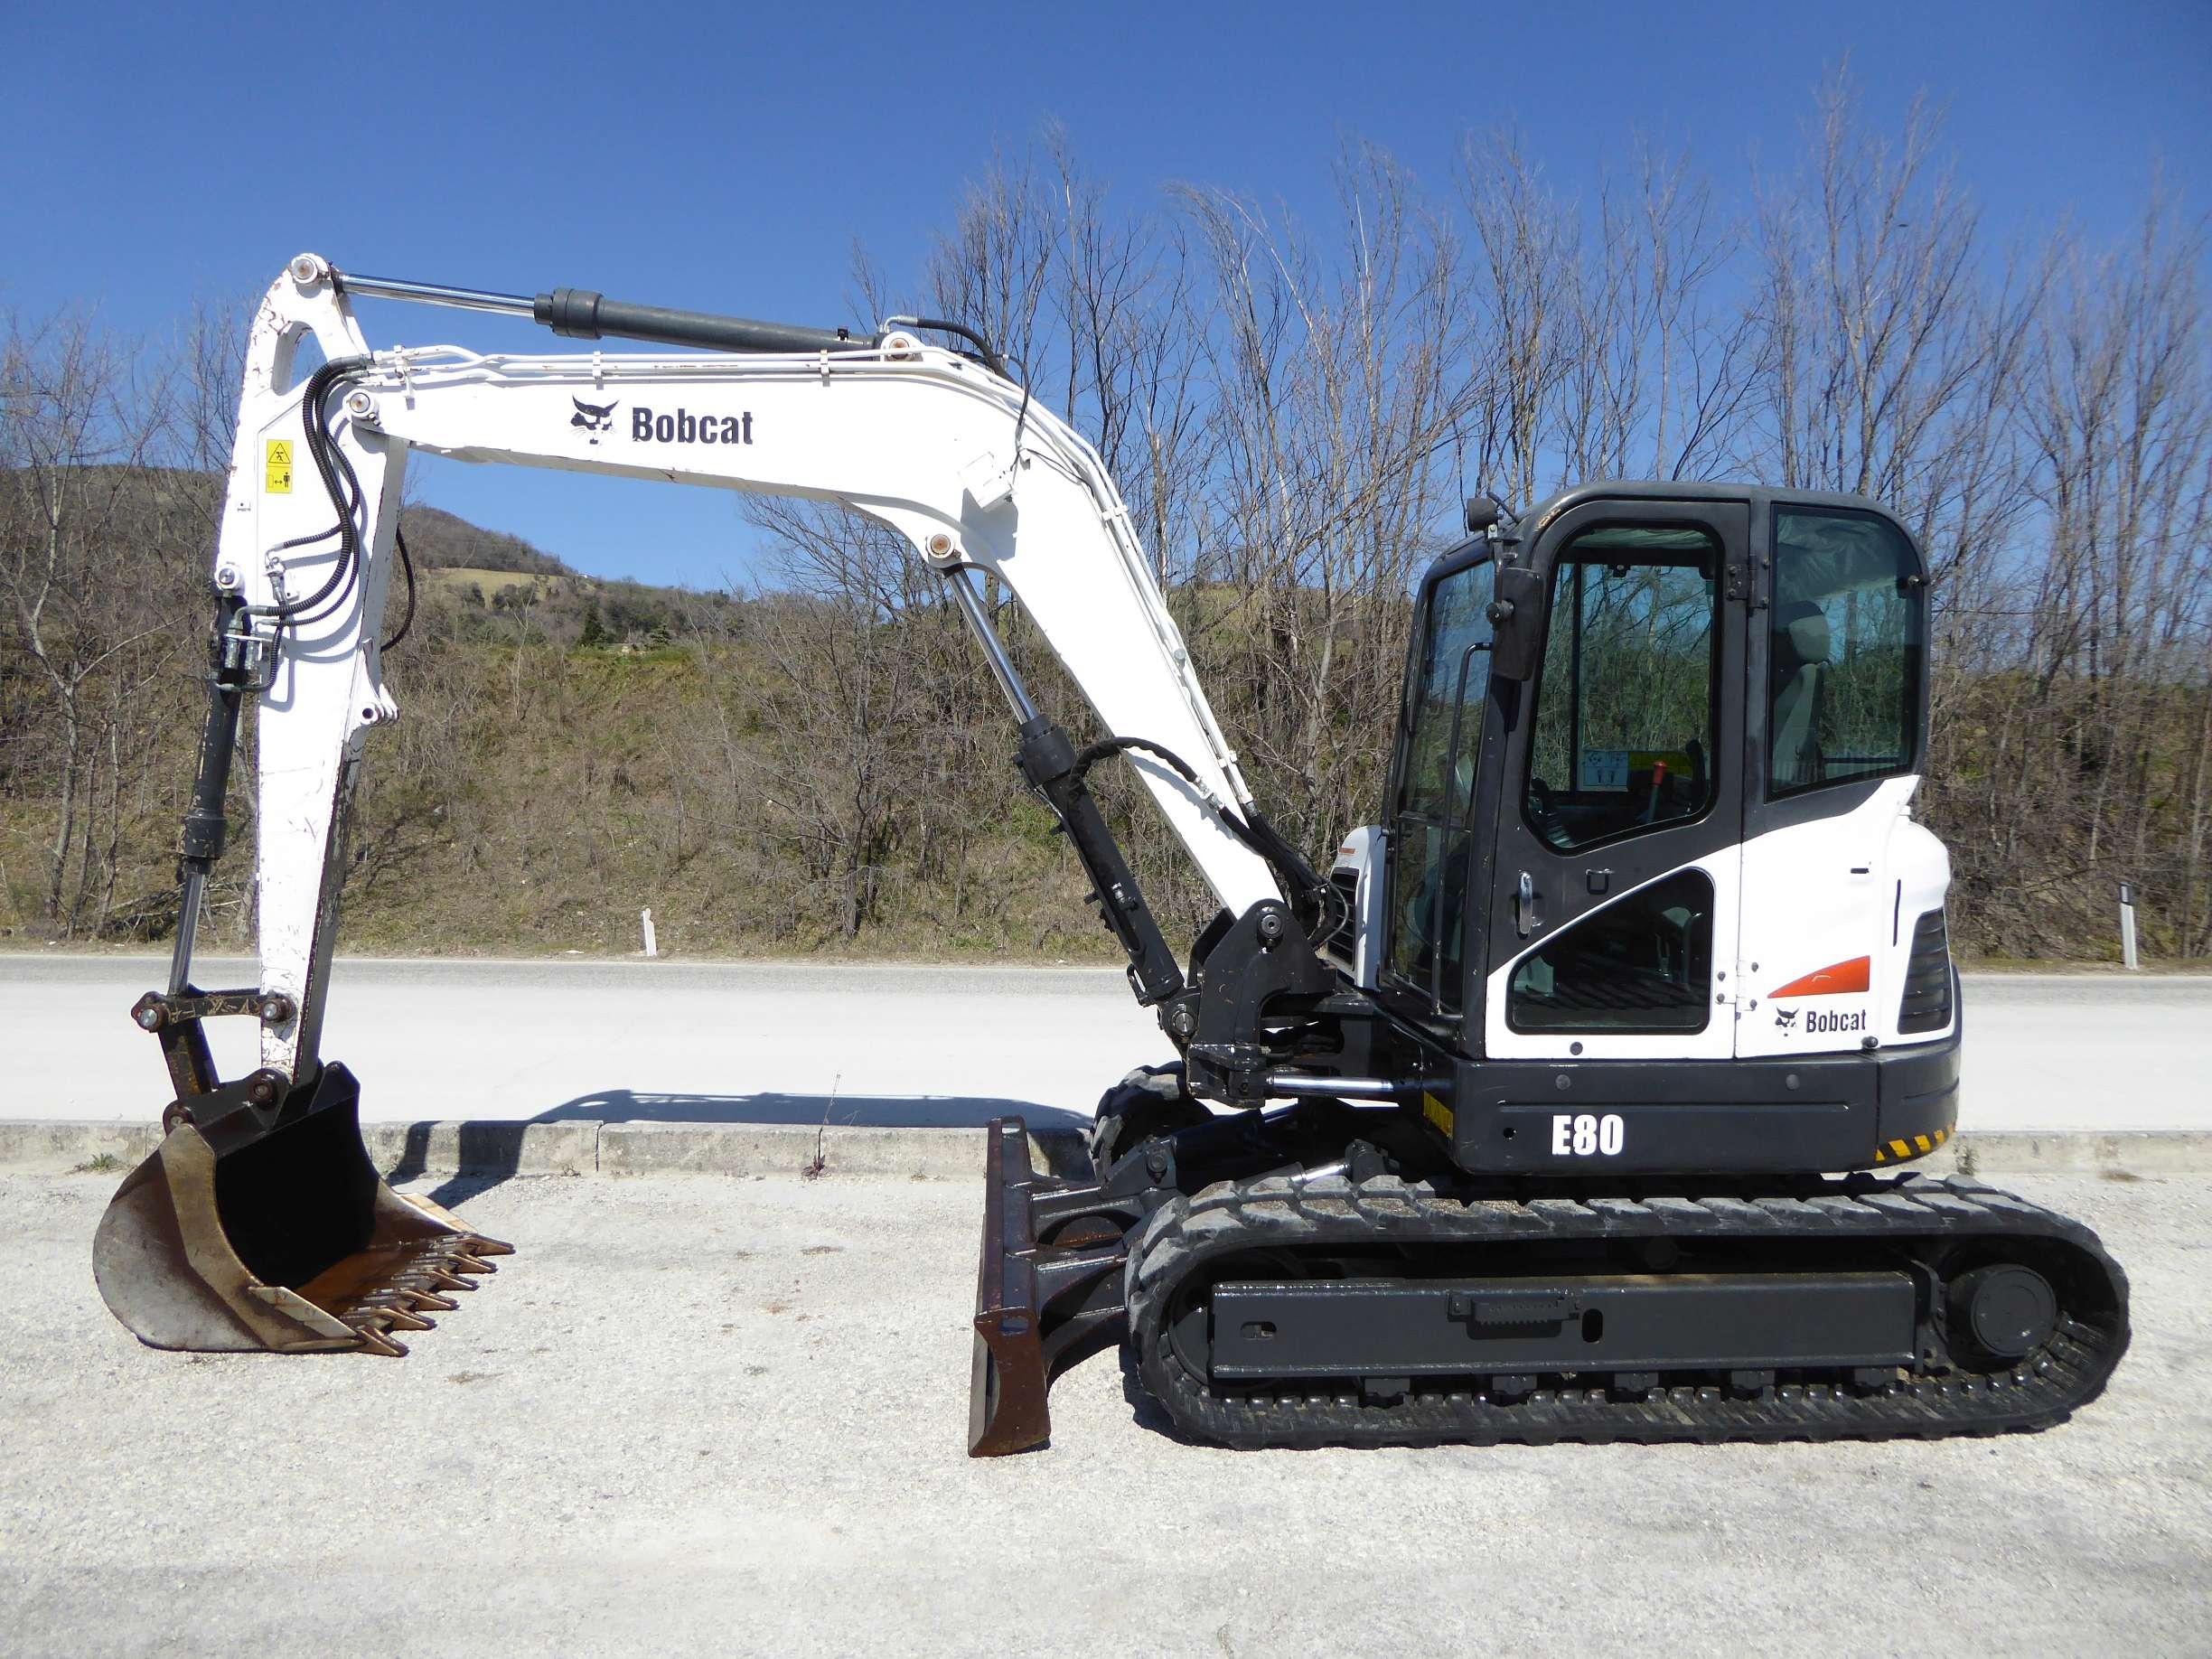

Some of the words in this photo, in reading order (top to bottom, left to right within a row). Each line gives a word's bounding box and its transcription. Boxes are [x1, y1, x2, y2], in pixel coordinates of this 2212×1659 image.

[633, 407, 754, 445] Bobcat
[1806, 1009, 1867, 1033] Bobcat
[1551, 1114, 1624, 1156] E80
